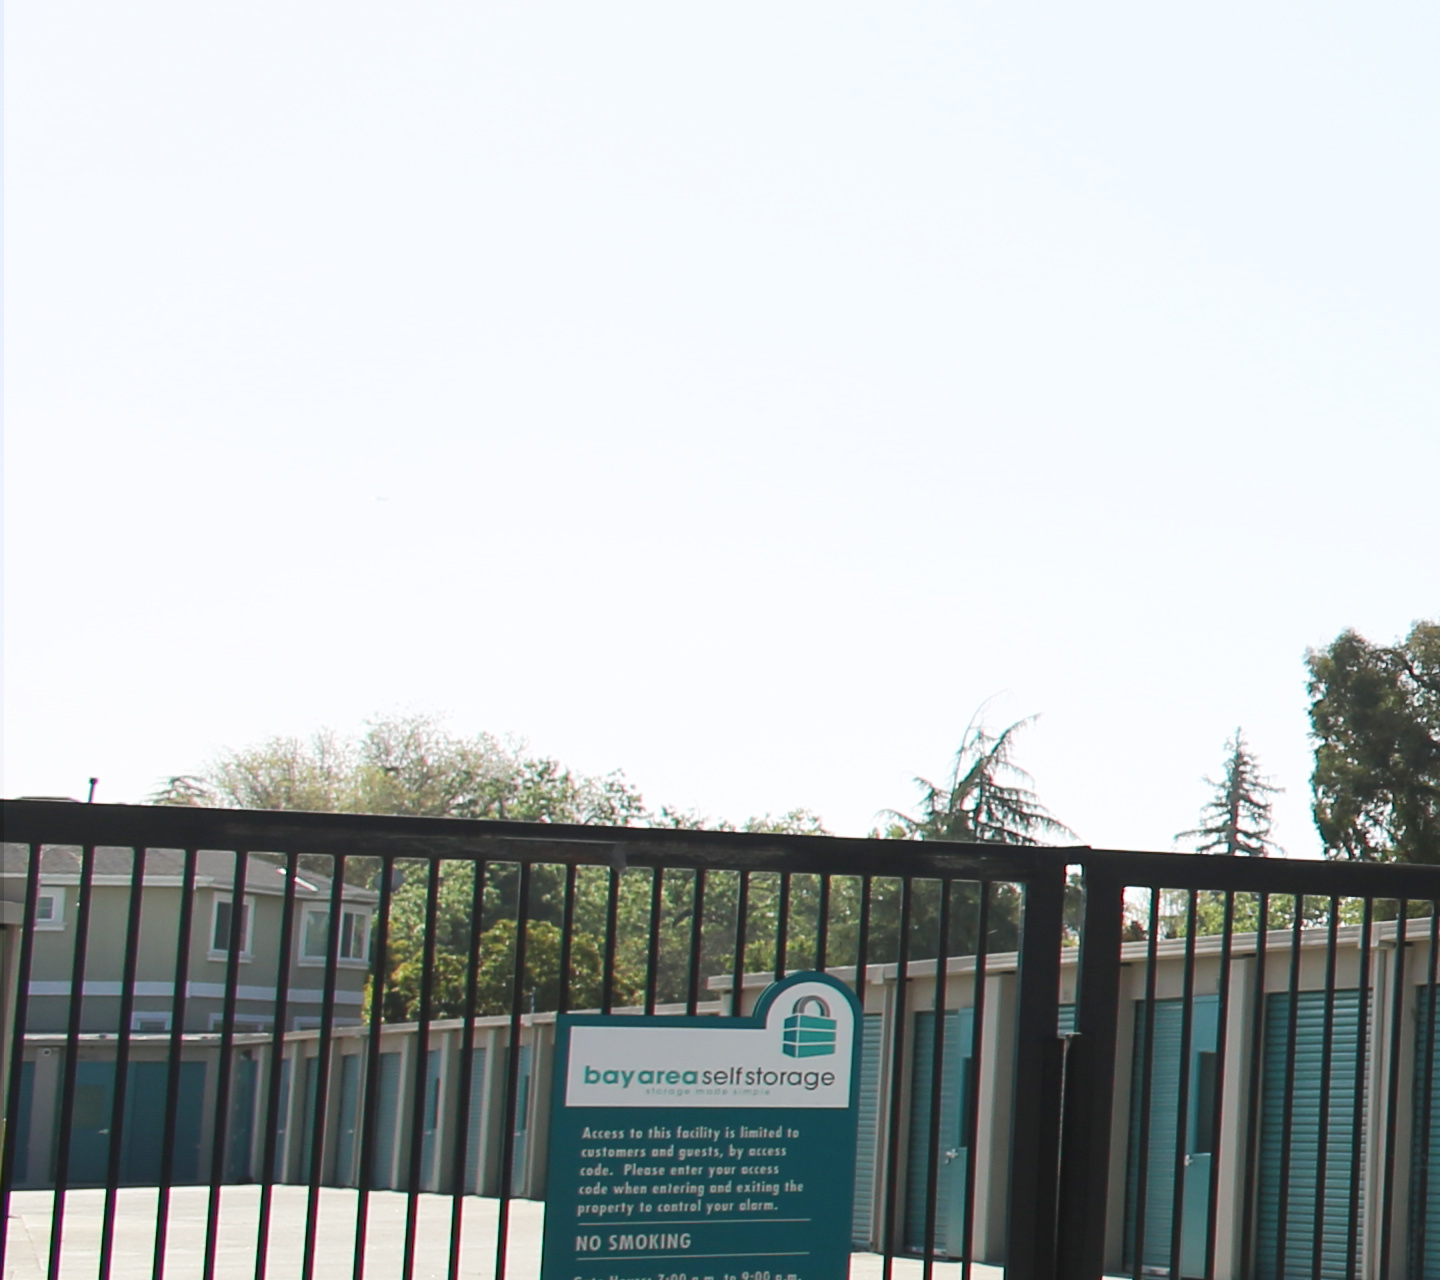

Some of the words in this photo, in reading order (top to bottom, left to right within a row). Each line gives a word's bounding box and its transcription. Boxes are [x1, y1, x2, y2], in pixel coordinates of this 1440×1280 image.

[696, 1087, 728, 1095] made
[581, 1127, 624, 1140] Access
[630, 1128, 643, 1139] to
[648, 1127, 671, 1139] this
[676, 1126, 721, 1141] facility
[725, 1126, 735, 1138] is
[740, 1126, 782, 1138] limited
[787, 1128, 799, 1138] to
[580, 1146, 646, 1158] customers
[651, 1145, 674, 1157] and
[678, 1146, 723, 1160] guests,
[728, 1144, 744, 1159] by
[748, 1147, 787, 1157] access
[579, 1164, 613, 1176] code.
[623, 1164, 665, 1175] Please
[670, 1166, 703, 1175] enter
[708, 1165, 736, 1178] your
[741, 1165, 779, 1175] access
[578, 1182, 608, 1195] code
[613, 1182, 647, 1195] when
[652, 1182, 705, 1196] entering
[709, 1181, 732, 1193] and
[736, 1181, 780, 1195] exiting
[784, 1180, 804, 1193] the
[577, 1201, 634, 1216] property
[639, 1201, 652, 1213] to
[657, 1199, 701, 1213] control
[706, 1201, 734, 1215] your
[739, 1198, 778, 1211] alarm.
[575, 1235, 602, 1252] NO
[608, 1233, 691, 1251] SMOKING
